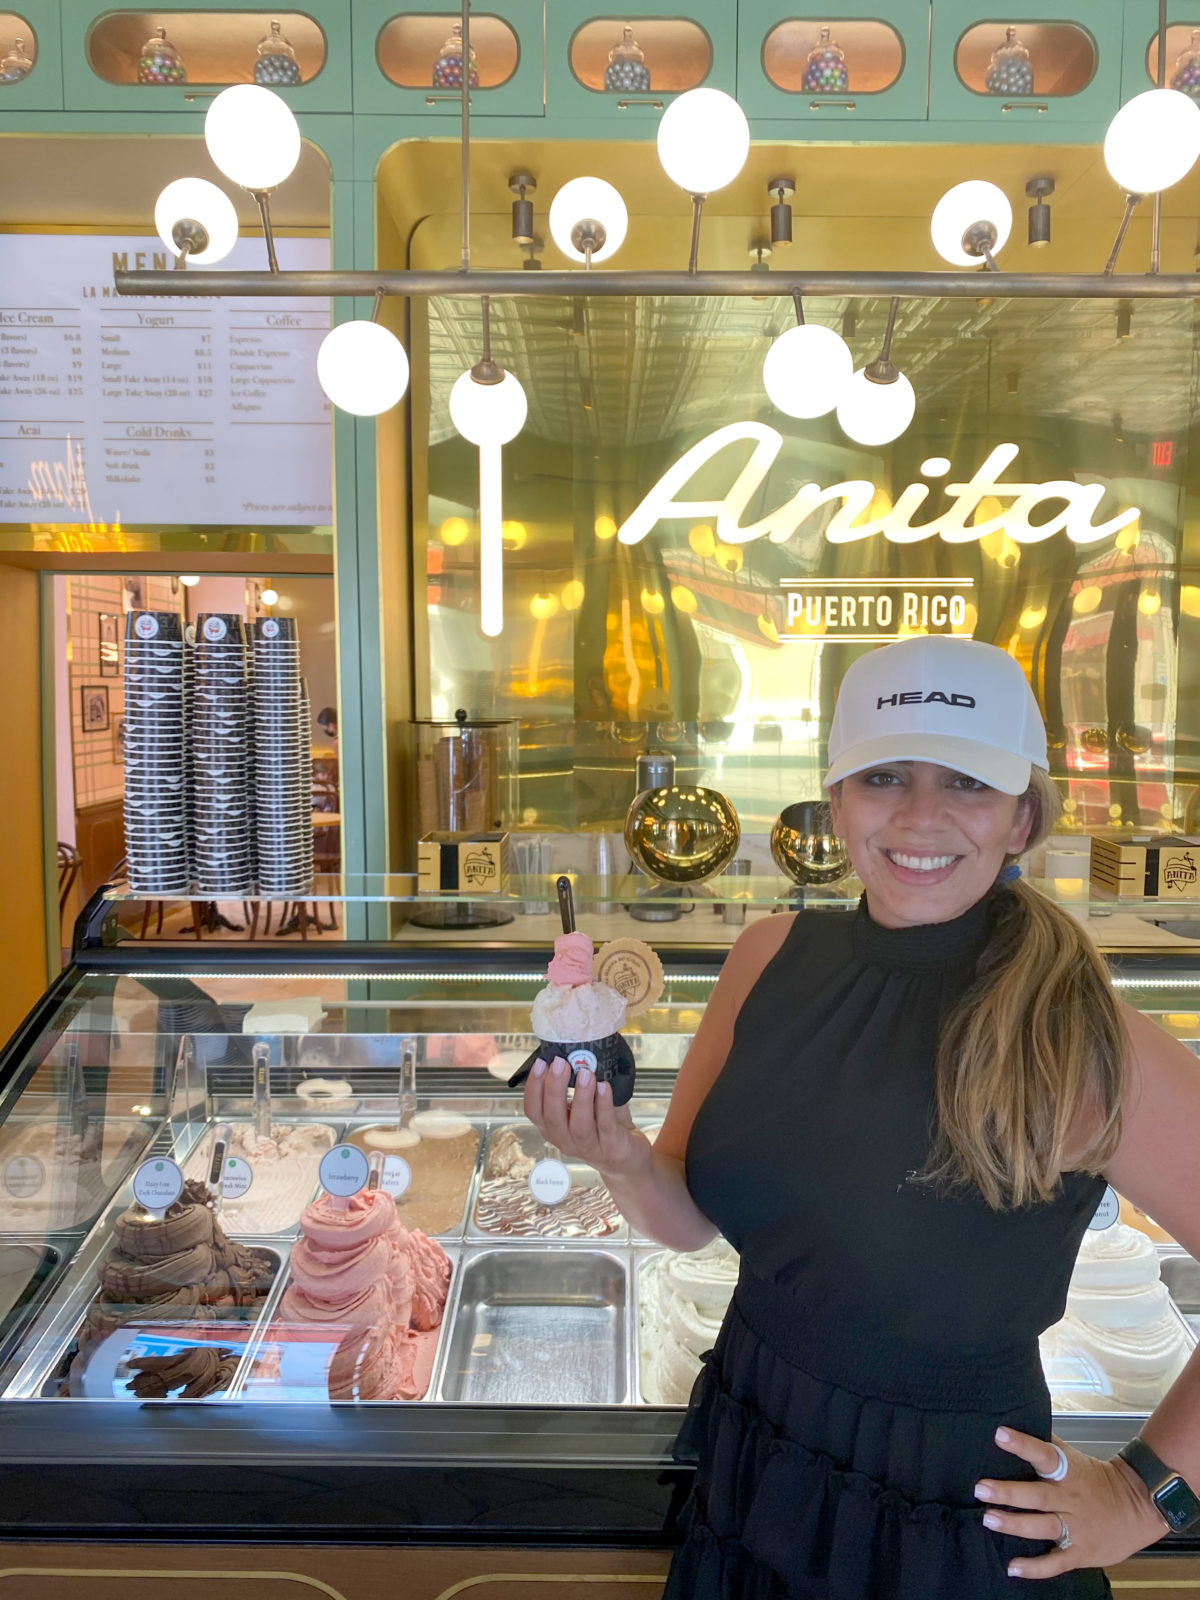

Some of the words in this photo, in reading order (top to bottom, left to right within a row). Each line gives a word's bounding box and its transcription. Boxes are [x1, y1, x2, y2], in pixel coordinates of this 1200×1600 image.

[112, 252, 187, 272] MEN
[18, 312, 54, 323] Cream
[137, 313, 175, 326] Yogurt
[266, 314, 302, 326] Coffee
[126, 426, 152, 438] Cold
[154, 426, 192, 438] Drinks
[617, 420, 1141, 545] Anita
[786, 592, 893, 628] PUERTO
[901, 592, 966, 628] RICO
[876, 691, 976, 710] HEAD
[1167, 870, 1195, 880] ANITA
[327, 1173, 360, 1184] Strawberry
